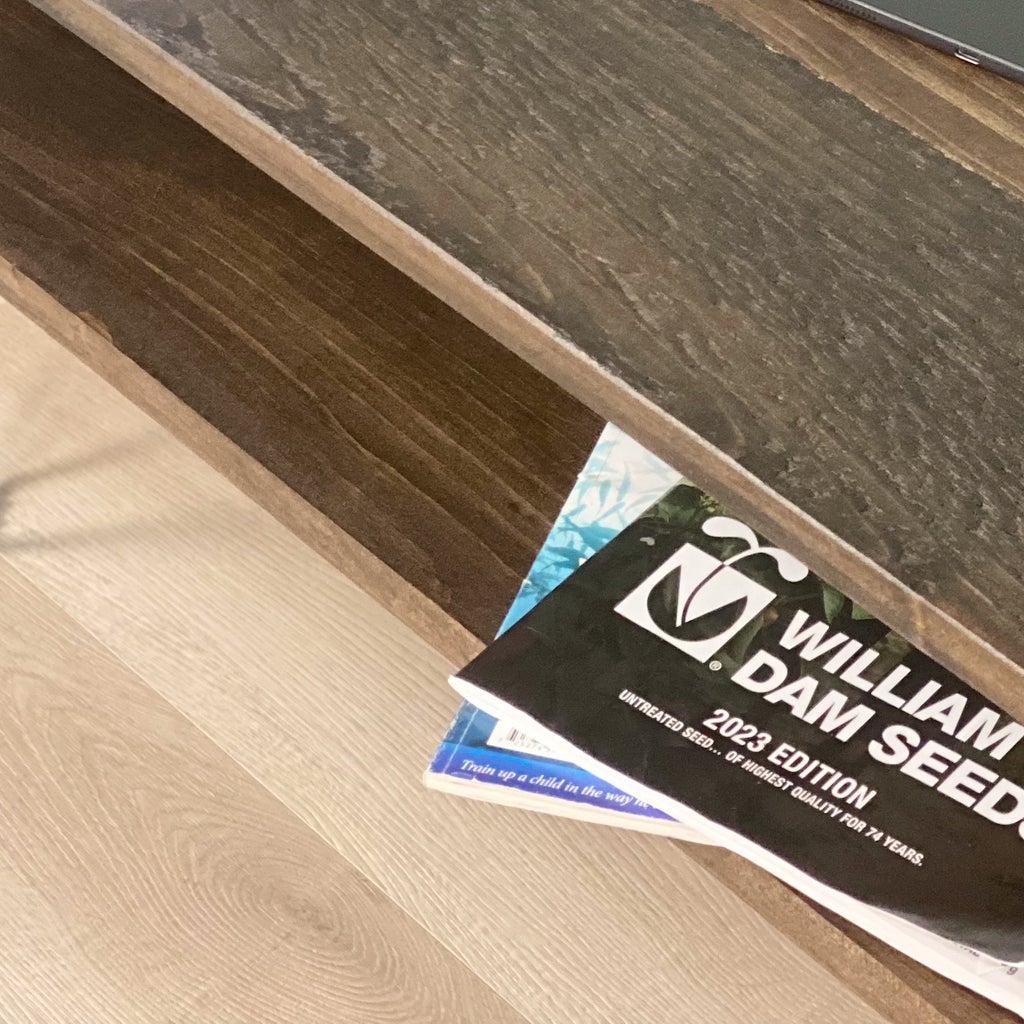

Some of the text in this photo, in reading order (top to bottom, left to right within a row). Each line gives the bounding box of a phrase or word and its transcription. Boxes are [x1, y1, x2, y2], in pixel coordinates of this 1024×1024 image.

[731, 649, 876, 743] DAM
[460, 760, 497, 775] Train
[497, 768, 516, 781] up
[530, 775, 563, 790] child
[566, 783, 579, 793] in
[581, 786, 603, 799] the
[605, 793, 633, 807] way
[618, 689, 924, 866] UNTREATED SEED... OF HIGHEST QUALITY FOR 74 YEARS.
[703, 708, 876, 810] 2023 EDITION
